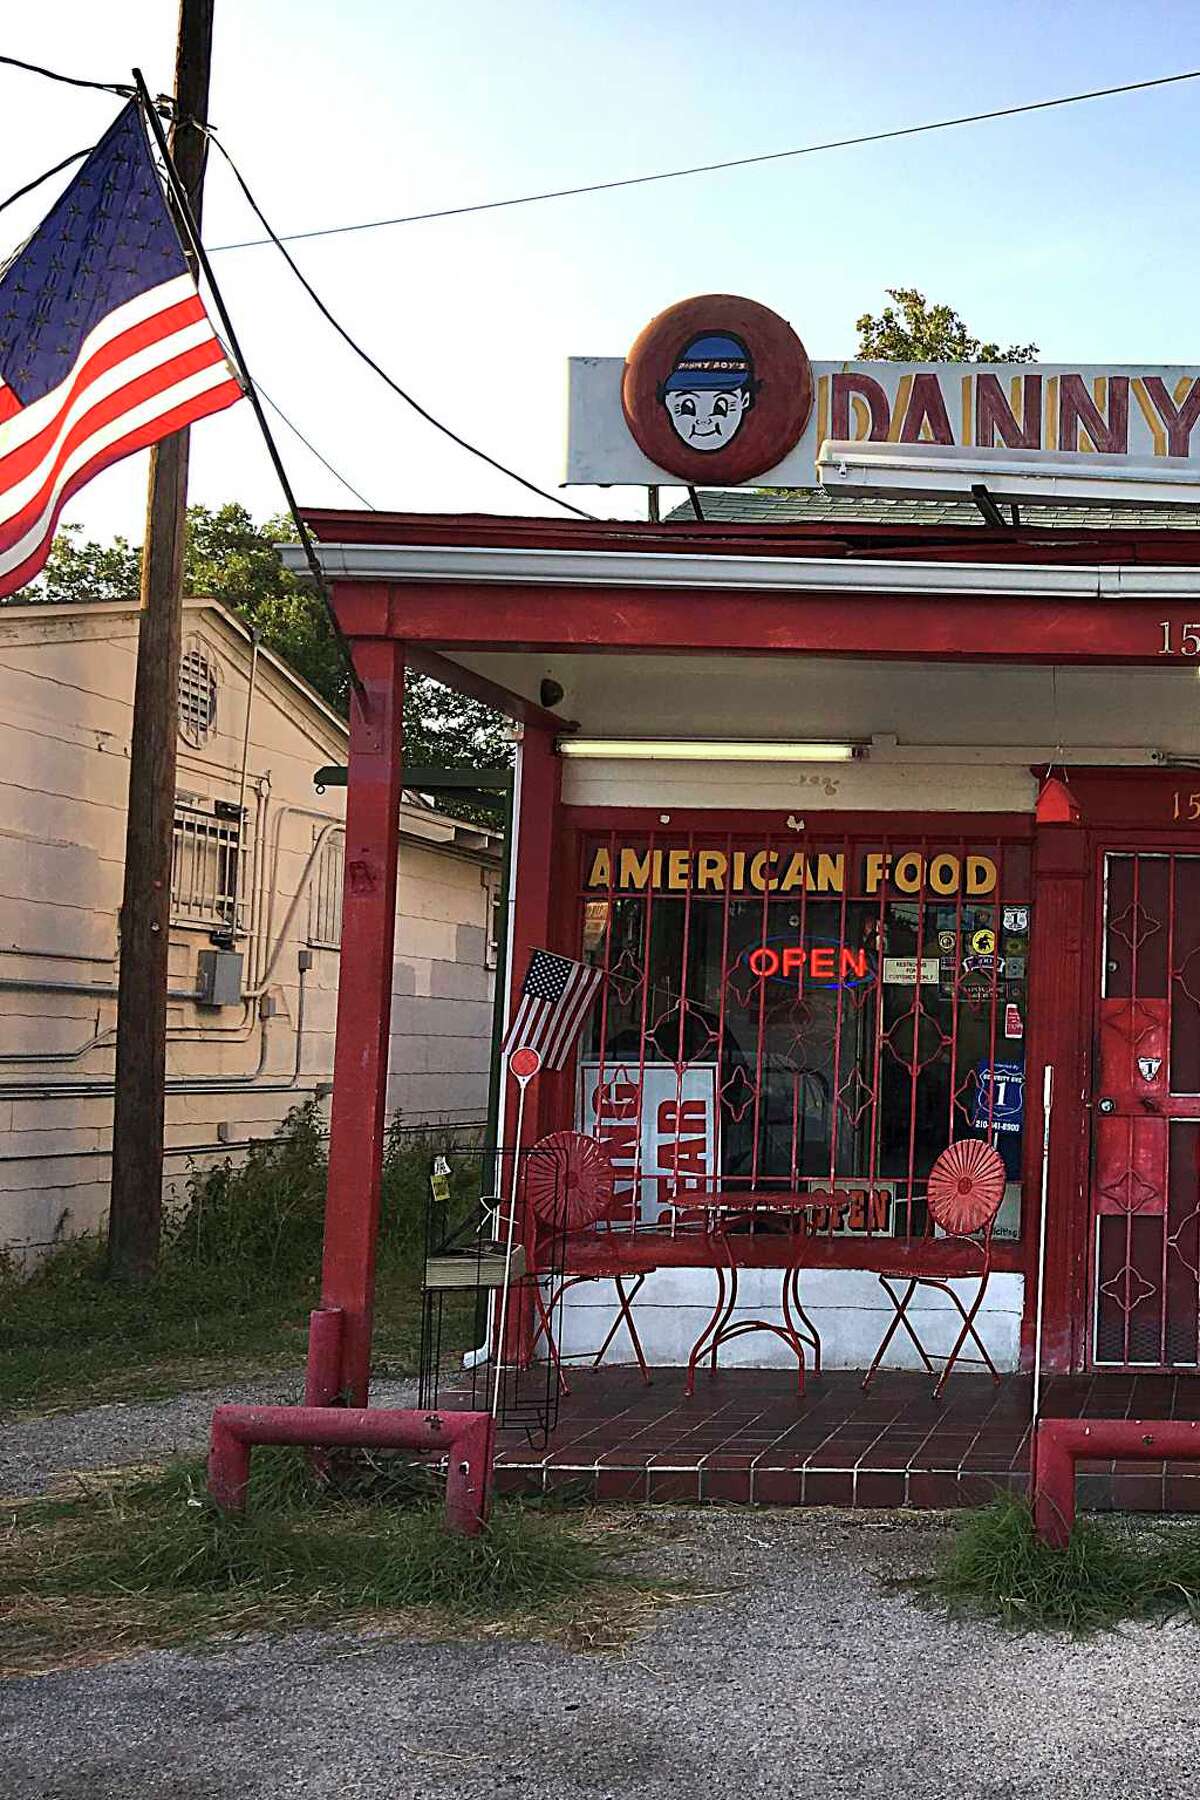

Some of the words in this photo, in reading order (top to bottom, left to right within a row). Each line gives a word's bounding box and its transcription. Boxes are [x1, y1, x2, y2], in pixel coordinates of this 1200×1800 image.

[678, 362, 711, 370] DANNY
[587, 847, 846, 893] AMERICAN
[865, 851, 997, 895] FOOD
[749, 946, 867, 978] OPEN
[982, 1073, 1010, 1082] SEURITY
[994, 1082, 1007, 1106] 1
